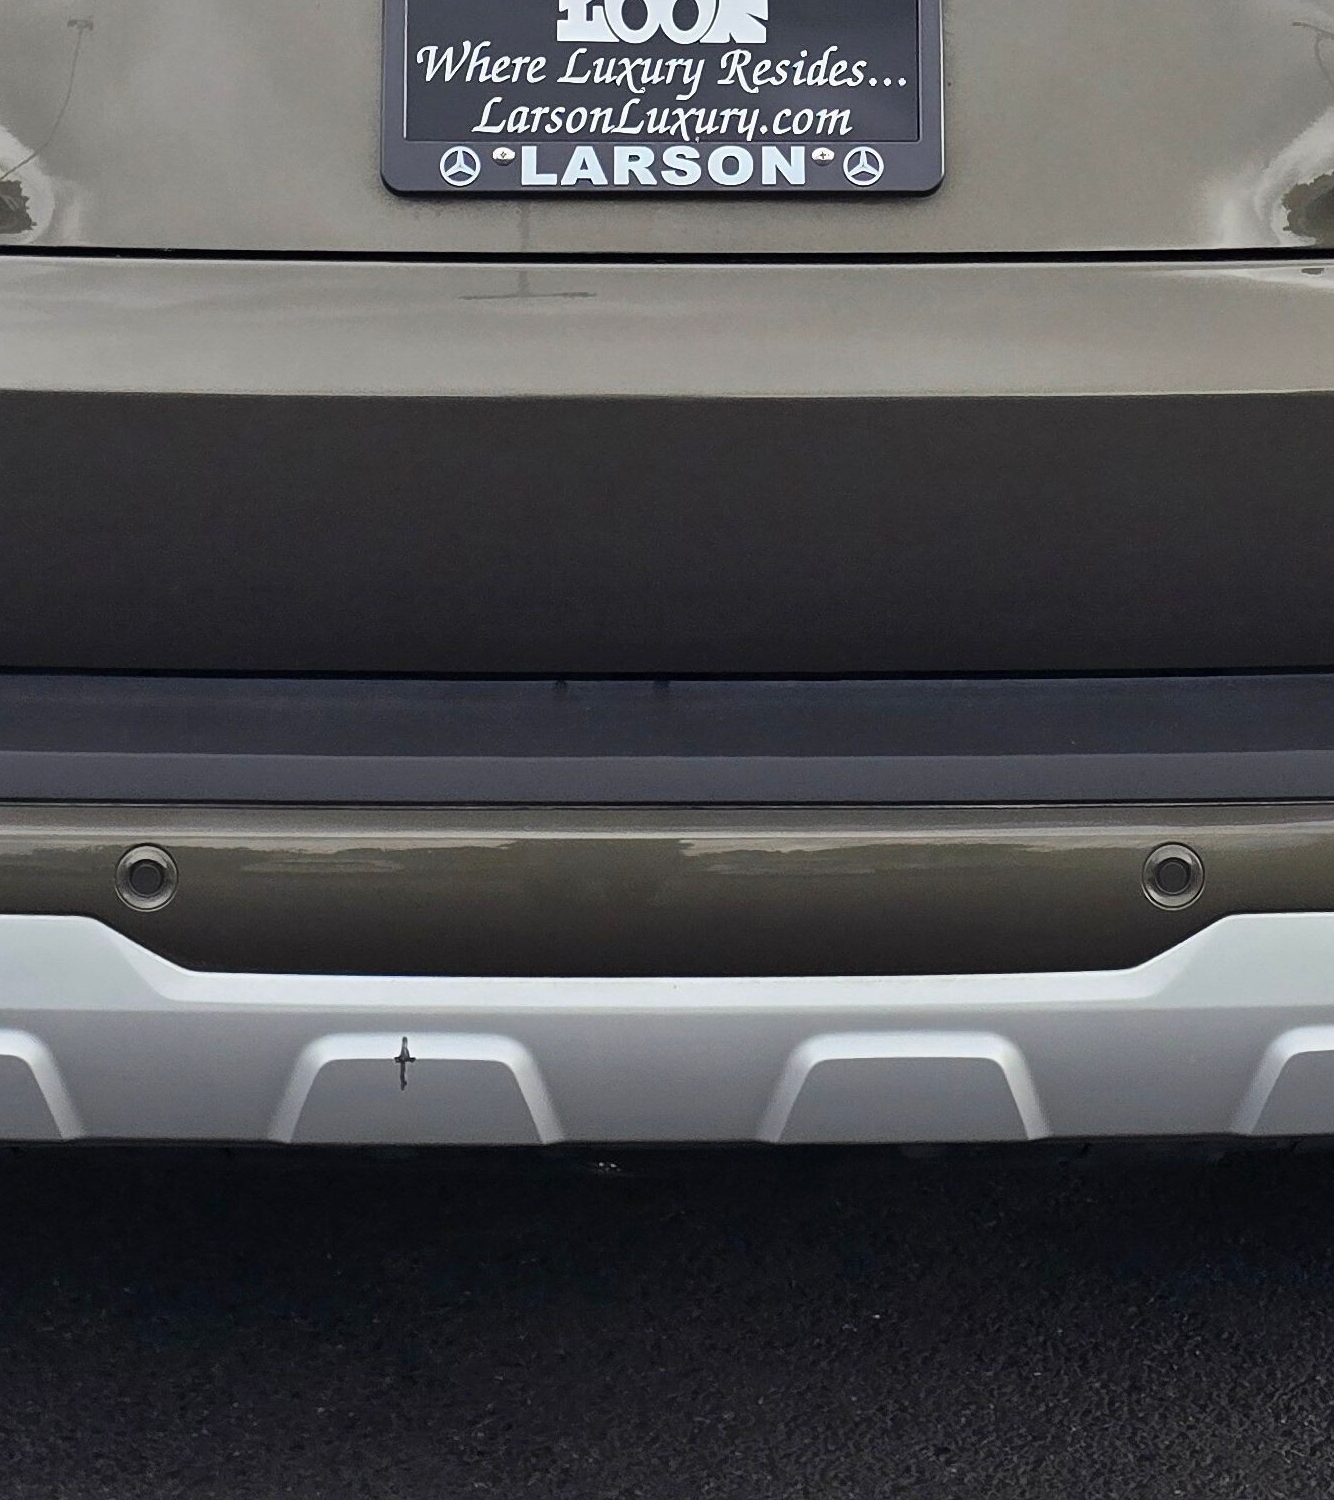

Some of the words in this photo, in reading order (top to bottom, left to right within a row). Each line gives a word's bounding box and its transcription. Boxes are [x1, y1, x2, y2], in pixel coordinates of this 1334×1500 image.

[415, 40, 547, 86] Where
[556, 47, 705, 101] Luxury
[716, 45, 908, 92] Resides...
[470, 96, 854, 143] LarsonLuxury.com
[520, 145, 806, 187] LARSON
